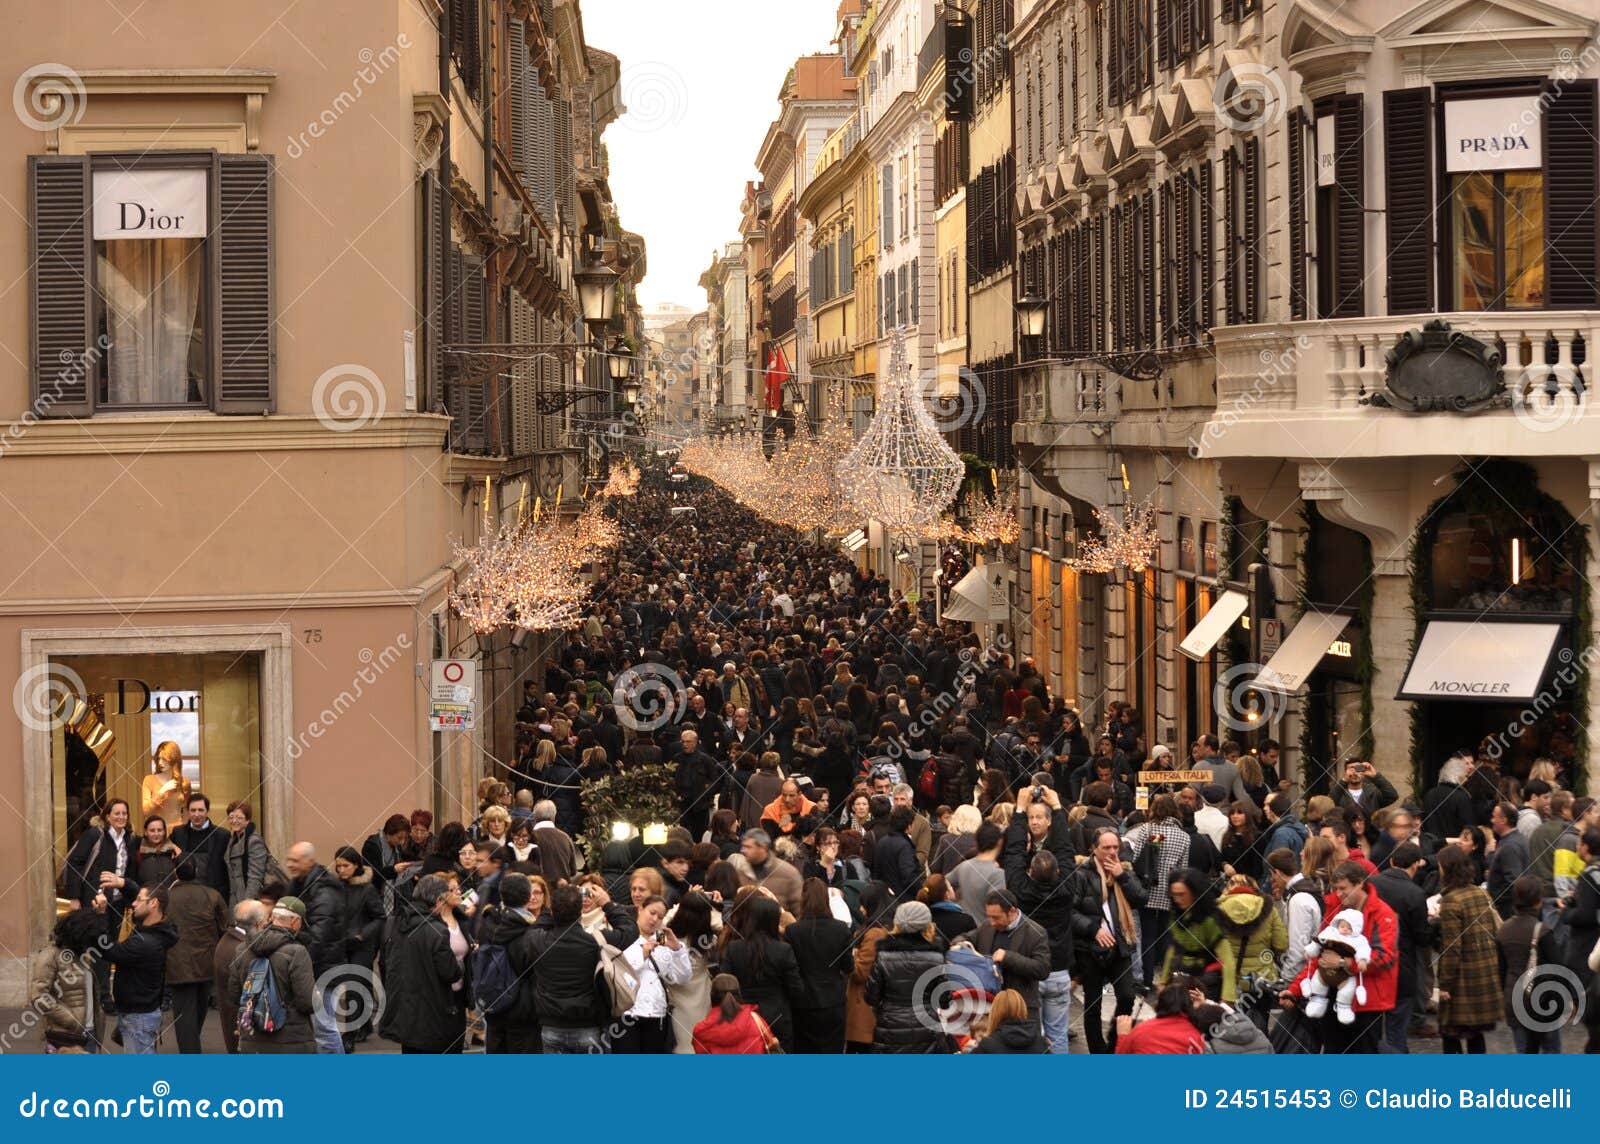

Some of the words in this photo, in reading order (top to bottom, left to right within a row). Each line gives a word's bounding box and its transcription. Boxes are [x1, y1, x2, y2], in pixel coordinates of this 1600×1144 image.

[1460, 136, 1529, 153] PRADA
[115, 202, 185, 231] Dior
[304, 629, 322, 644] 75
[1429, 680, 1511, 694] MONCLER
[112, 678, 202, 715] Dior
[1183, 771, 1209, 780] ITALIA
